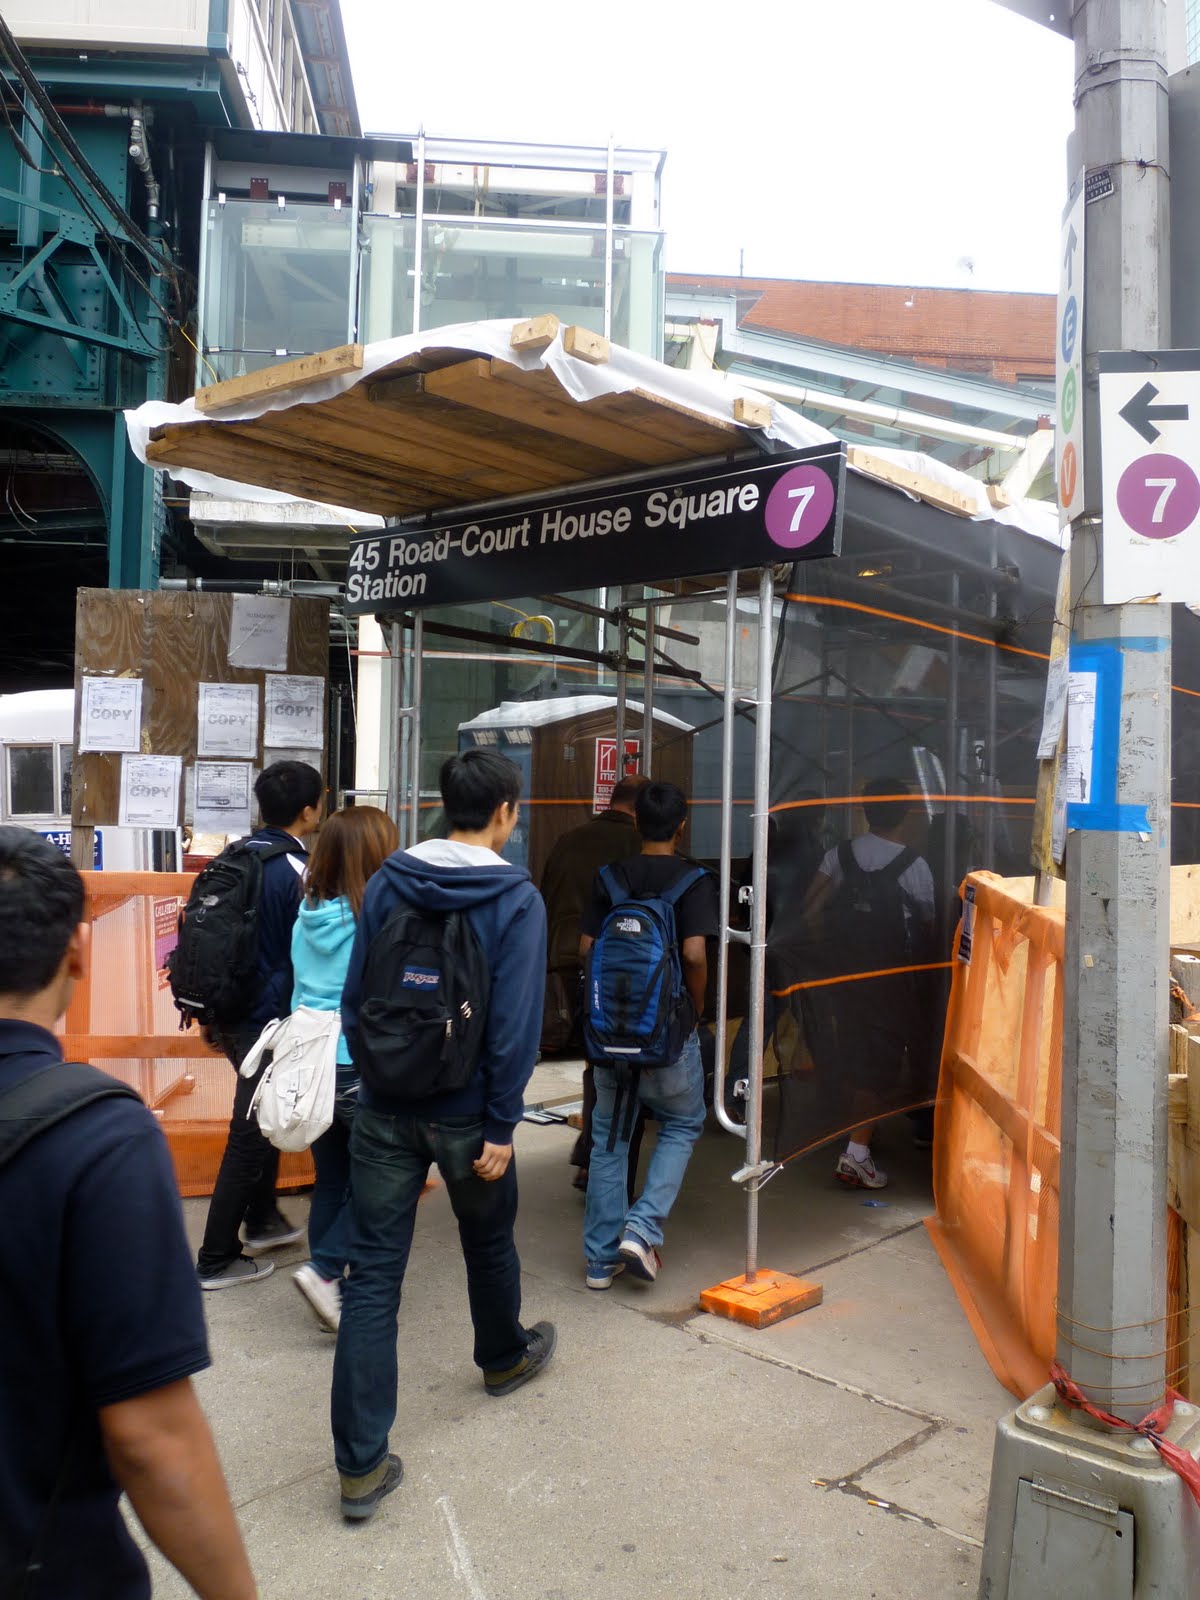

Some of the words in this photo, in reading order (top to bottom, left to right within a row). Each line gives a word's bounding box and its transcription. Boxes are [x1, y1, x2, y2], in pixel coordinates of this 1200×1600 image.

[1065, 310, 1074, 347] E
[1064, 381, 1073, 418] G
[1063, 451, 1073, 495] V
[788, 485, 816, 533] 7
[1145, 478, 1177, 523] 7
[349, 541, 381, 572] 45
[388, 517, 531, 567] Road-Court
[540, 506, 631, 544] House
[644, 483, 760, 529] Square
[346, 569, 427, 604] Station
[91, 708, 132, 720] COPY
[208, 714, 249, 726] COPY
[274, 704, 314, 717] COPY
[130, 786, 171, 798] COPY
